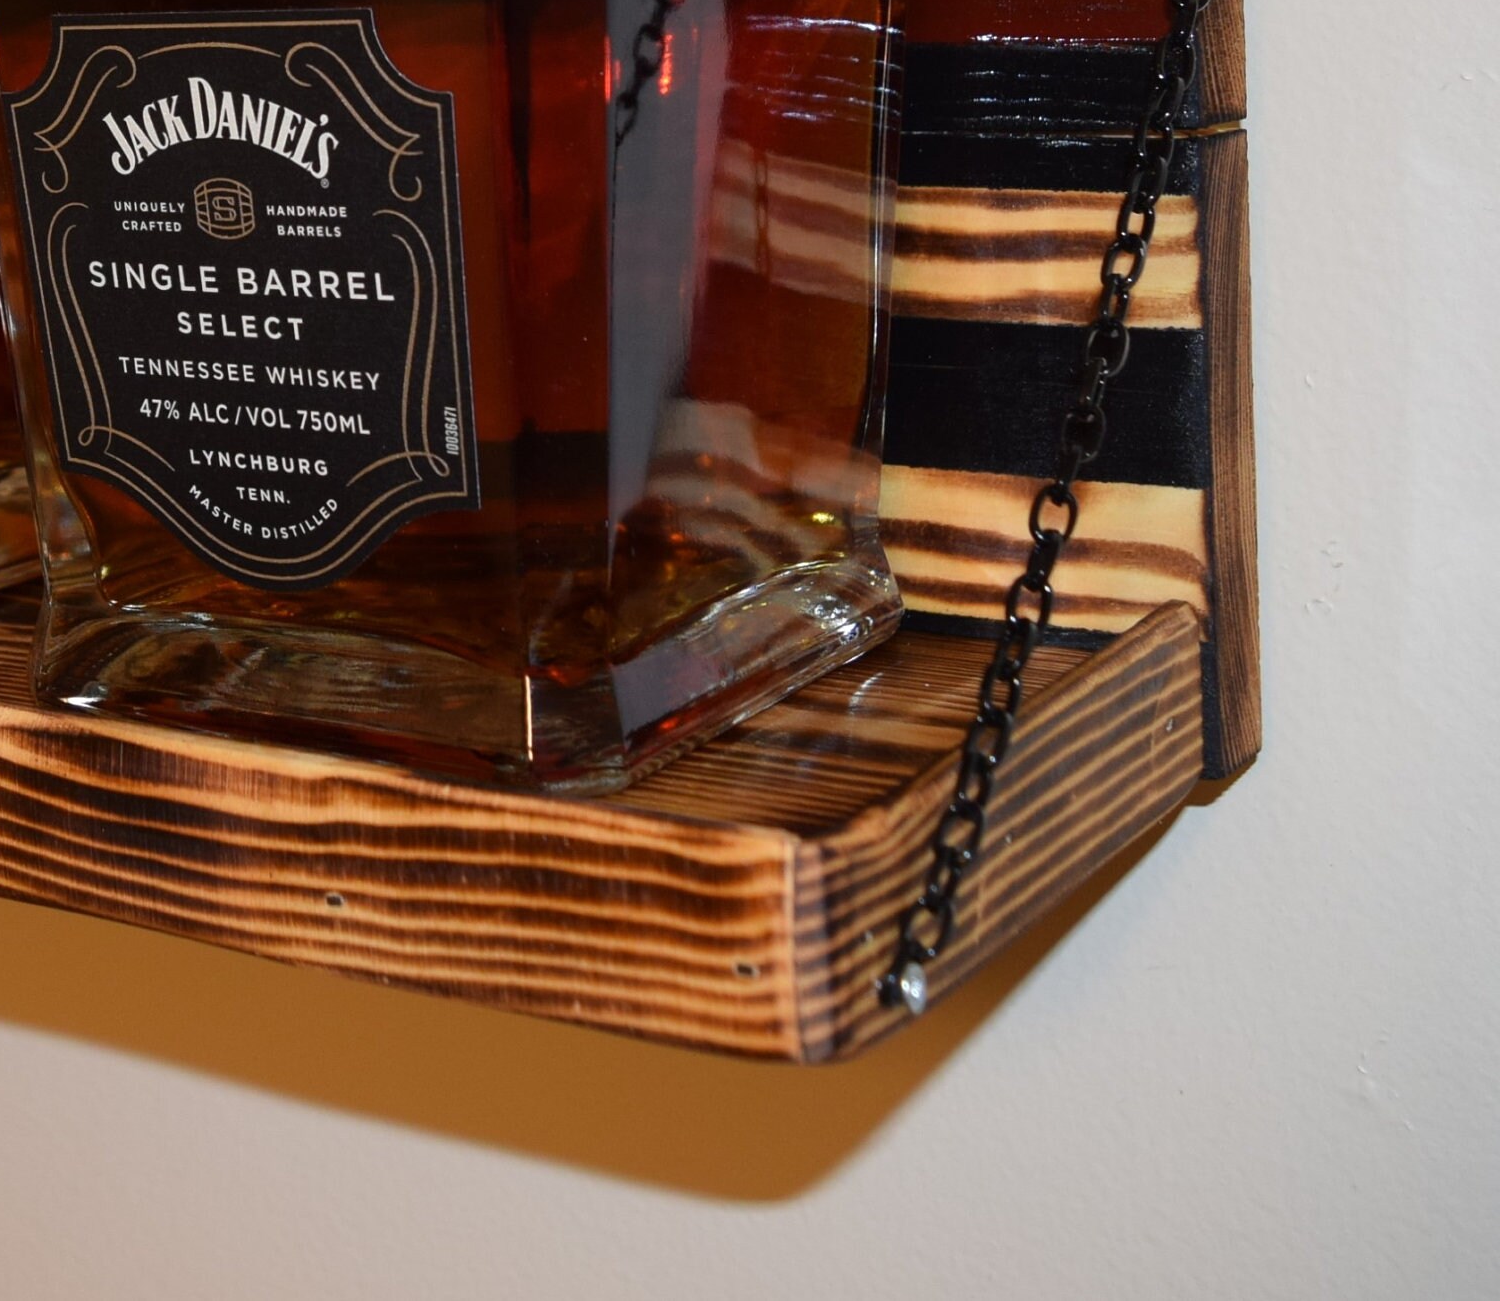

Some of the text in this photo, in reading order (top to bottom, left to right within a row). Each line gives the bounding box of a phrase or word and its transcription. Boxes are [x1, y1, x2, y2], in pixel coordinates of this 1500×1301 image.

[102, 76, 339, 179] JACK DANIEL'S
[113, 201, 185, 213] UNIQUELY
[266, 205, 348, 218] HANDMADE
[122, 220, 182, 233] CRAFTED
[277, 225, 342, 238] BARRELS
[88, 261, 395, 301] SINGLE BARREL
[177, 311, 303, 340] SELECT
[118, 356, 380, 391] TENNESSEE WHISKEY
[140, 398, 180, 420] 47%
[297, 410, 371, 435] 750ML
[444, 406, 459, 455] 10036471
[189, 449, 328, 476] LYNCHBURG
[236, 486, 290, 504] TENN.
[189, 485, 338, 538] MASTER DISTILLED
